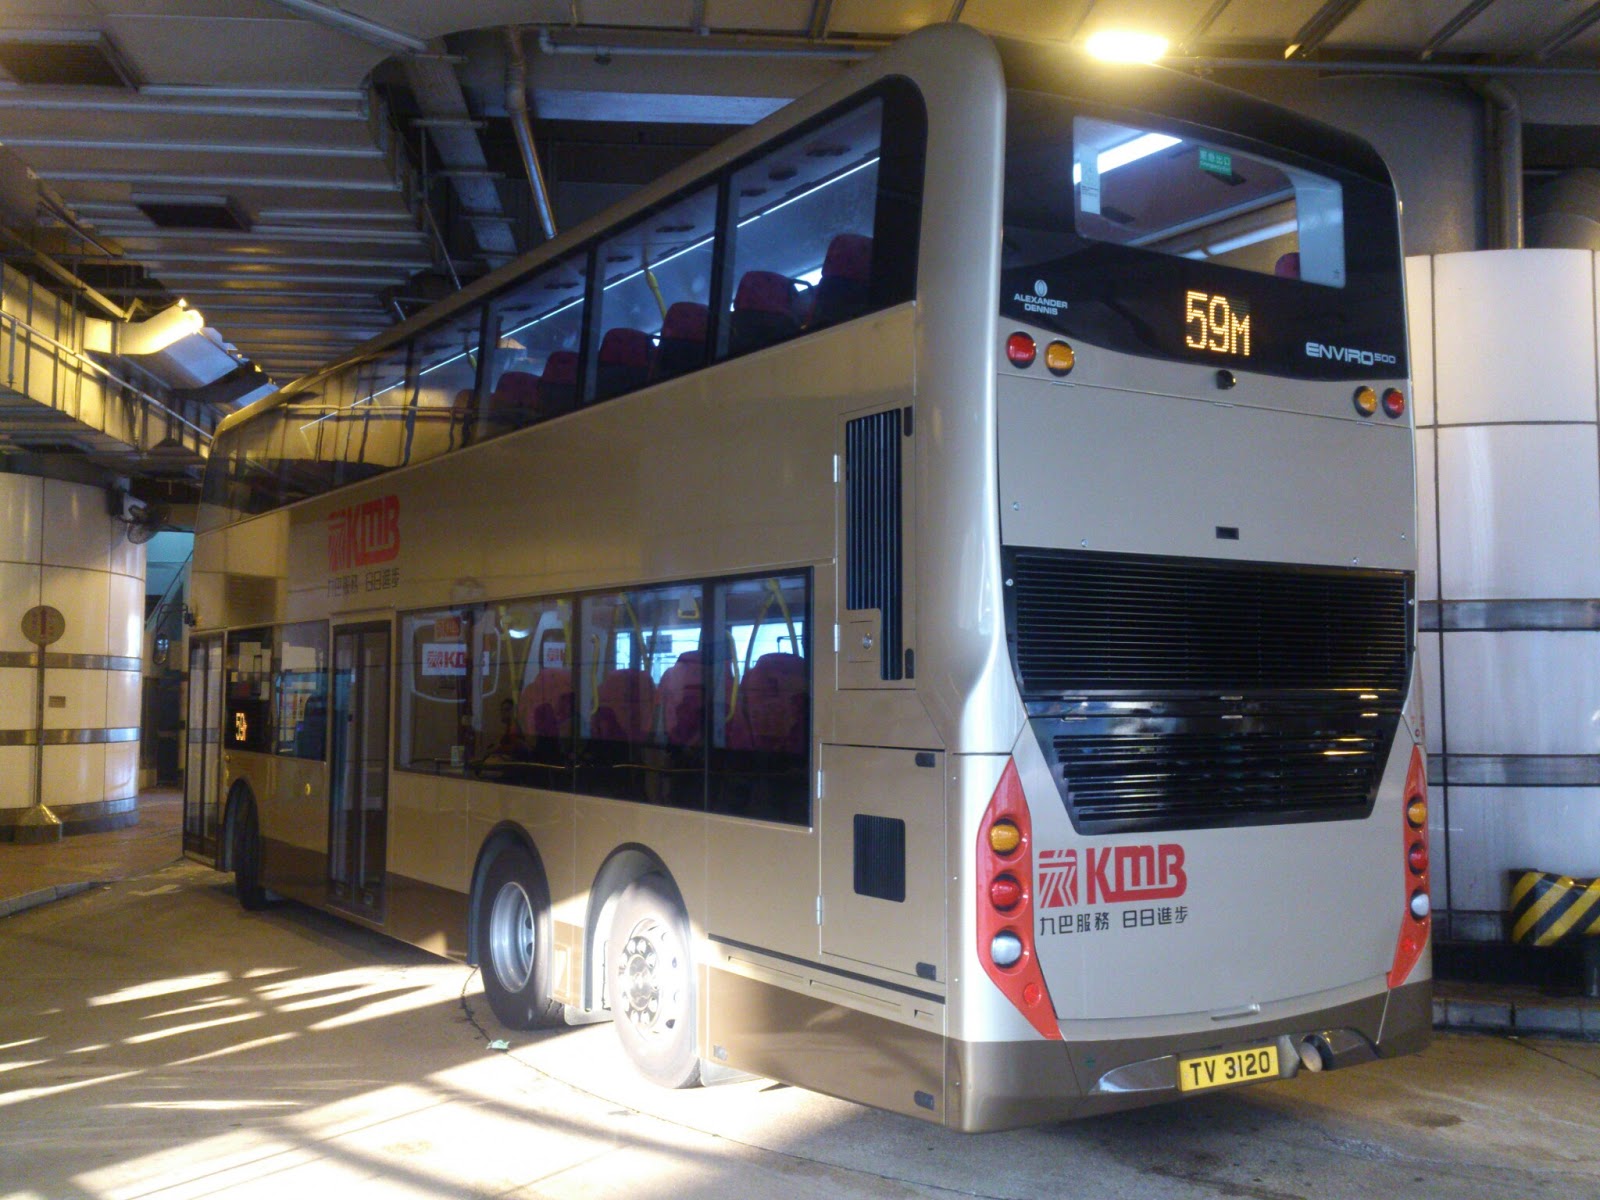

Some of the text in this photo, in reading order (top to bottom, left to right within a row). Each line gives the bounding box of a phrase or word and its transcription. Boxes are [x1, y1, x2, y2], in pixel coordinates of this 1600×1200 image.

[1014, 293, 1068, 309] ALEXANDER
[1024, 303, 1058, 316] DENNIS
[1186, 290, 1251, 356] 59M
[346, 494, 400, 569] KMB
[1086, 843, 1187, 905] KMB
[1040, 906, 1188, 936] 九巴服務 日日進步
[1190, 1051, 1270, 1086] TV 3120
